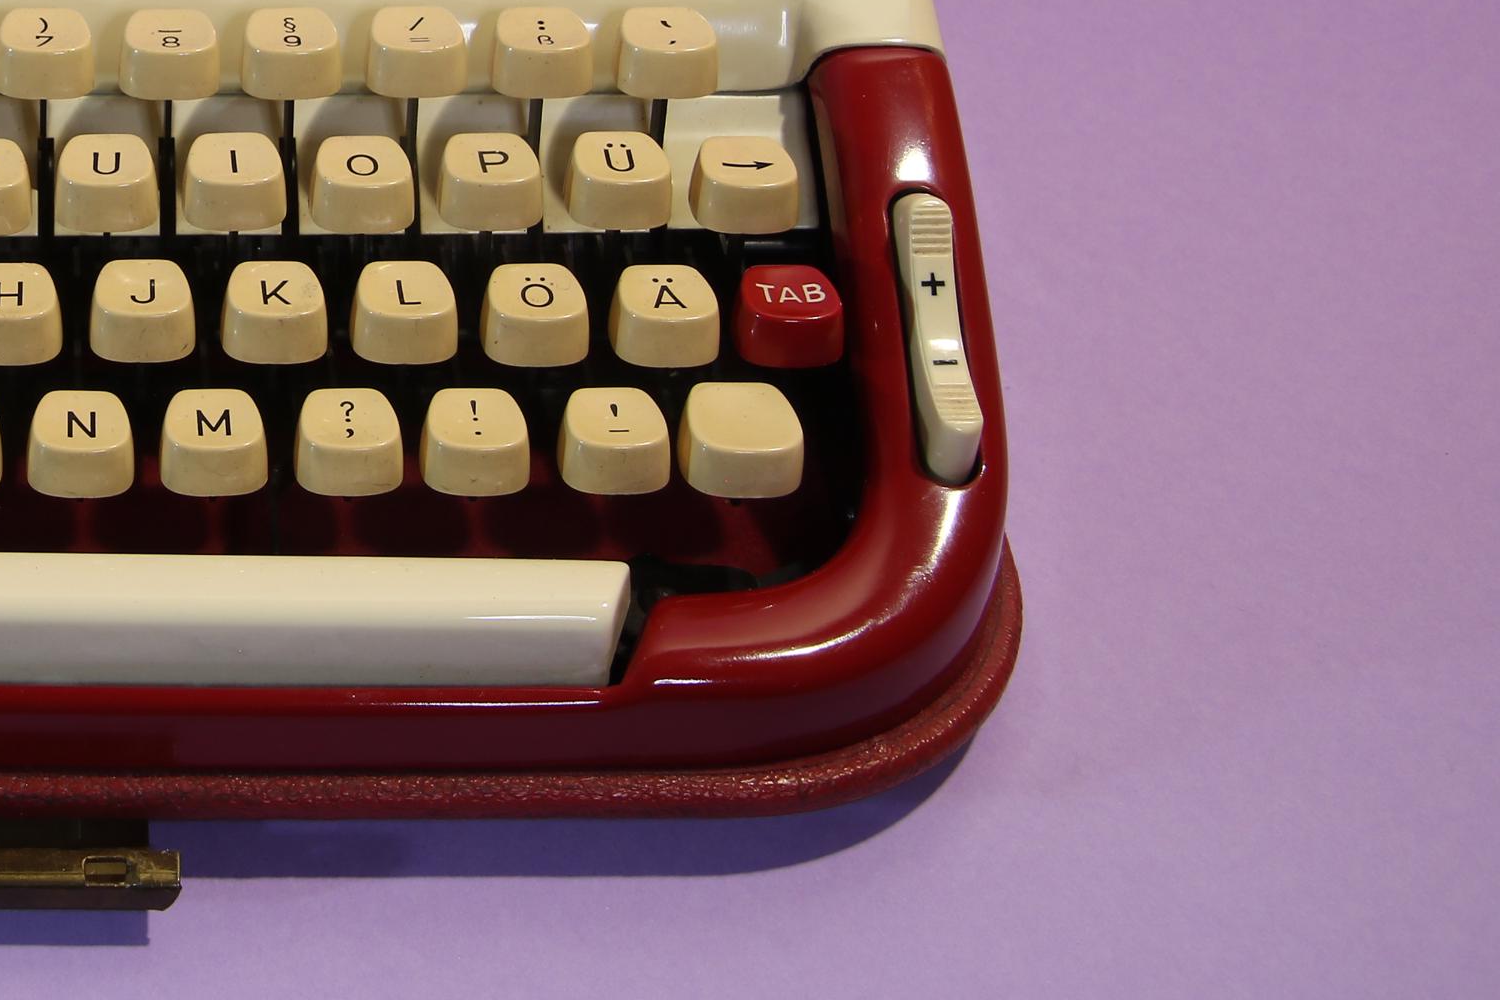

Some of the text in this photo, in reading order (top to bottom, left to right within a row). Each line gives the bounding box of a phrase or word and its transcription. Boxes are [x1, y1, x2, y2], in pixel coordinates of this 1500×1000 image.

[39, 17, 49, 34] )
[283, 17, 297, 34] §
[409, 16, 424, 32] /
[537, 20, 546, 31] :
[35, 35, 54, 47] 7
[161, 36, 181, 48] 8
[283, 35, 302, 47] 9
[92, 151, 121, 175] U
[229, 149, 238, 174] I
[346, 154, 379, 177] O
[477, 150, 509, 174] P
[603, 143, 635, 172] Ü
[130, 278, 156, 304] J
[260, 280, 292, 305] K
[395, 279, 422, 306] L
[520, 277, 554, 308] Ö
[652, 277, 688, 309] Ä
[755, 283, 826, 303] TAB
[920, 272, 946, 297] +
[196, 408, 232, 437] M
[339, 400, 355, 423] ?
[470, 399, 479, 422] !
[67, 410, 97, 439] N
